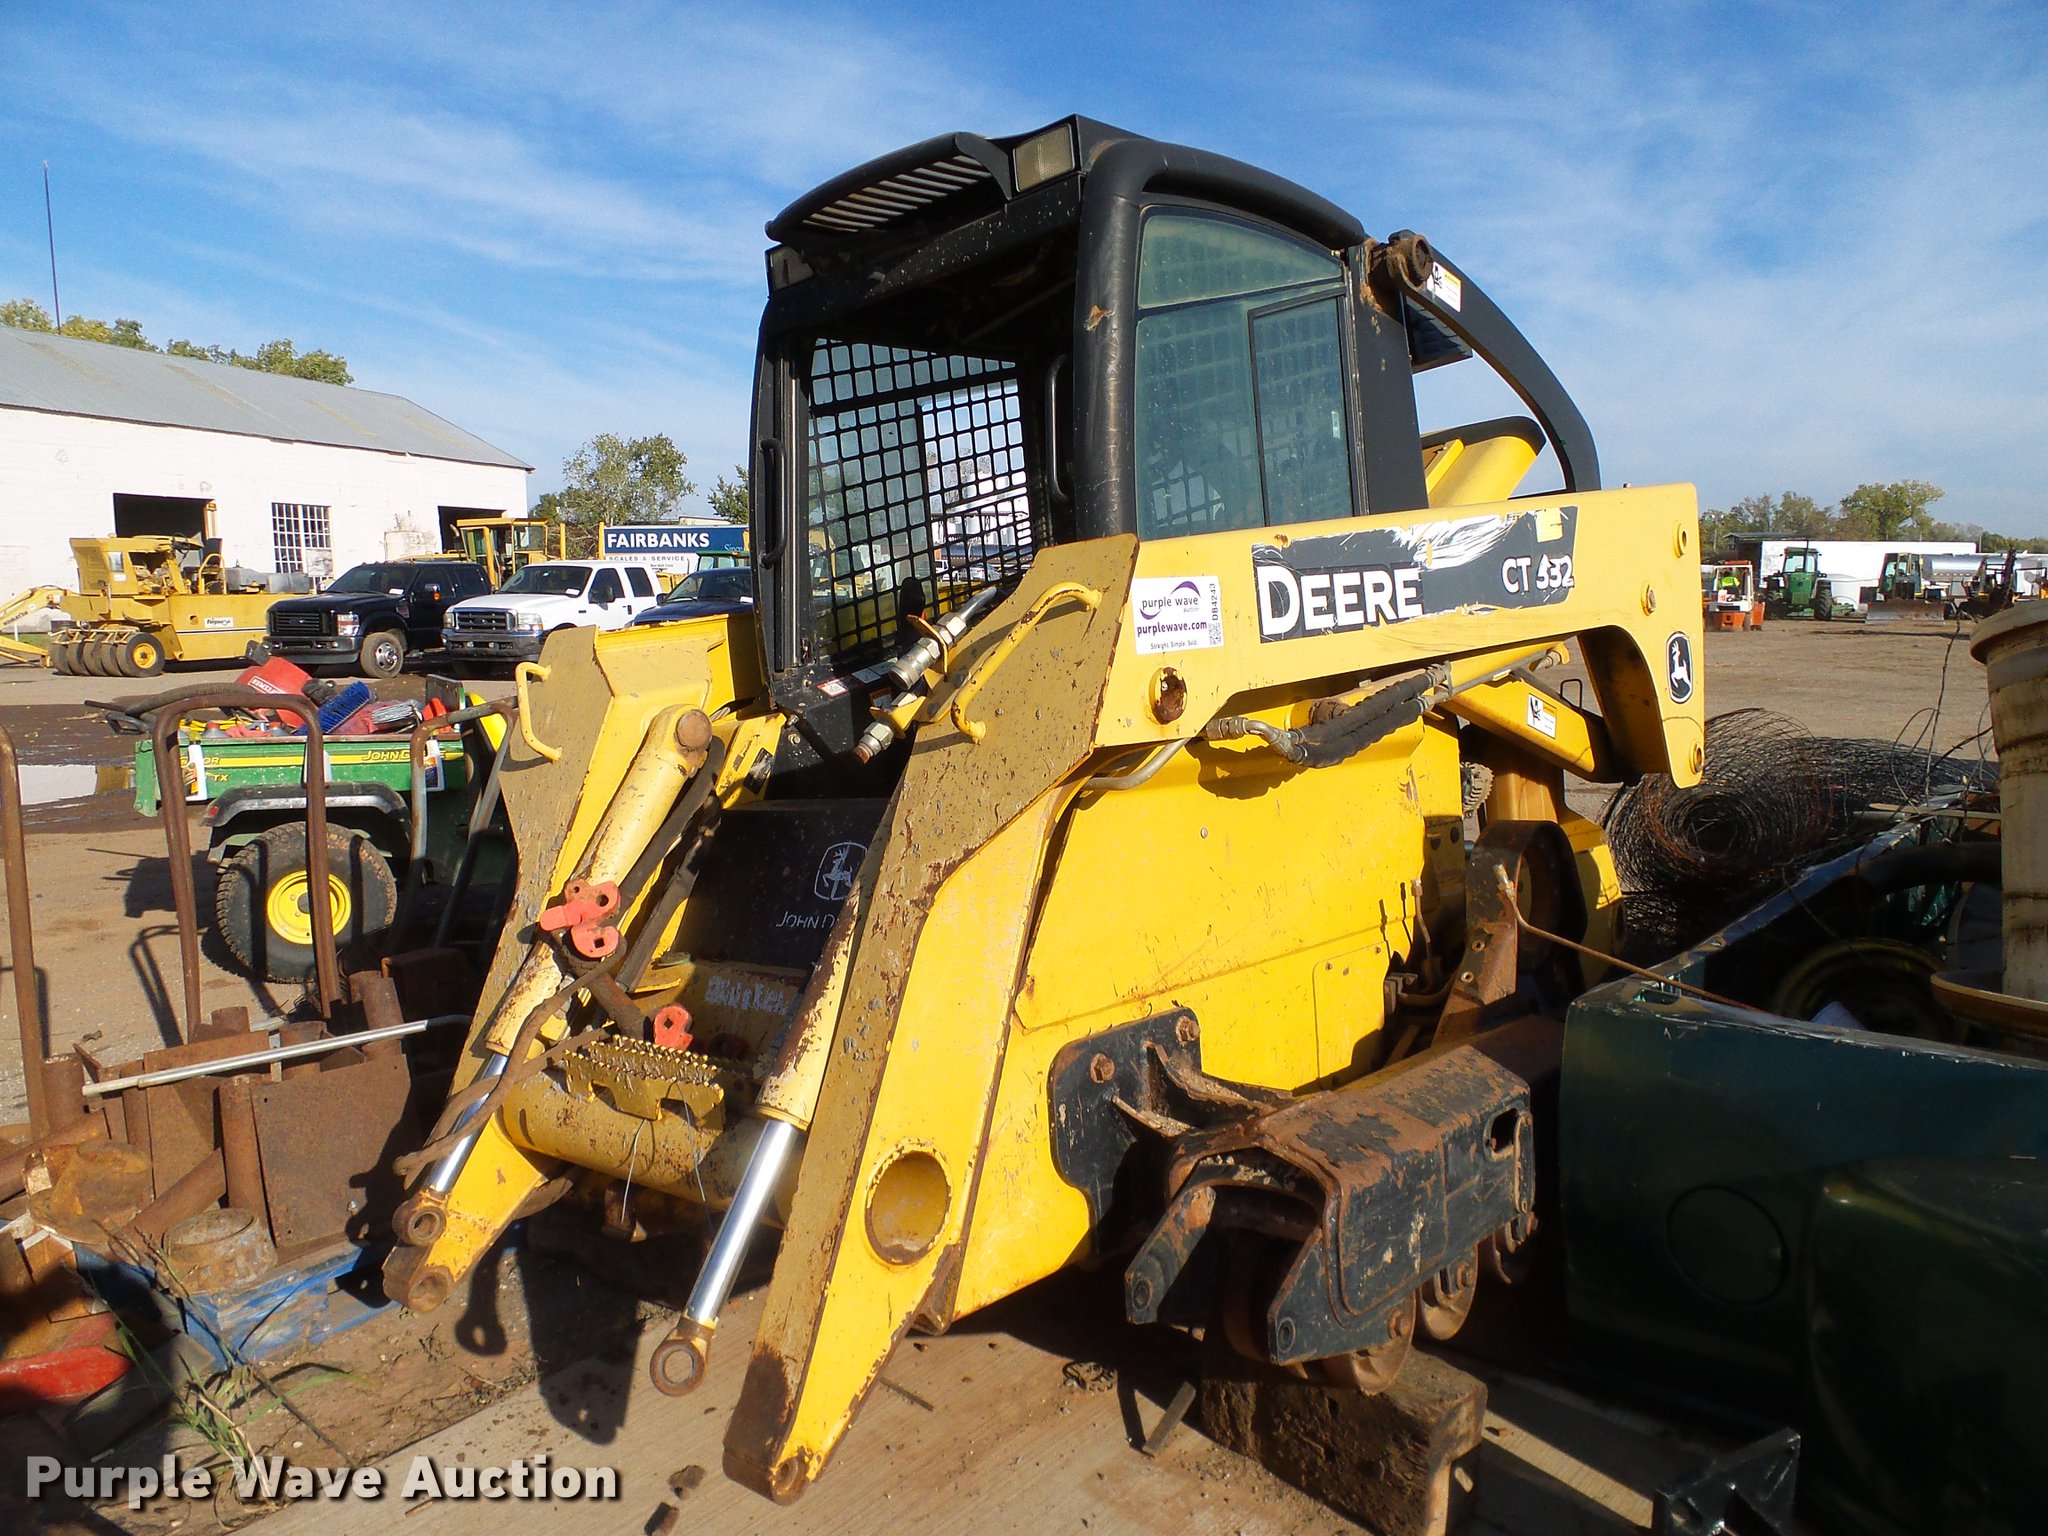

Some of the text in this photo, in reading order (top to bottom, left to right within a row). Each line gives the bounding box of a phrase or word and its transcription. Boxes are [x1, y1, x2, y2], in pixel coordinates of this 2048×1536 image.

[607, 533, 710, 548] FAIRBANKS
[1501, 556, 1531, 594] CT
[1142, 596, 1199, 611] purple wave
[1256, 564, 1424, 636] DEERE
[1136, 621, 1208, 637] purplewave.com
[362, 750, 400, 760] JOHN
[776, 911, 820, 929] JOHN
